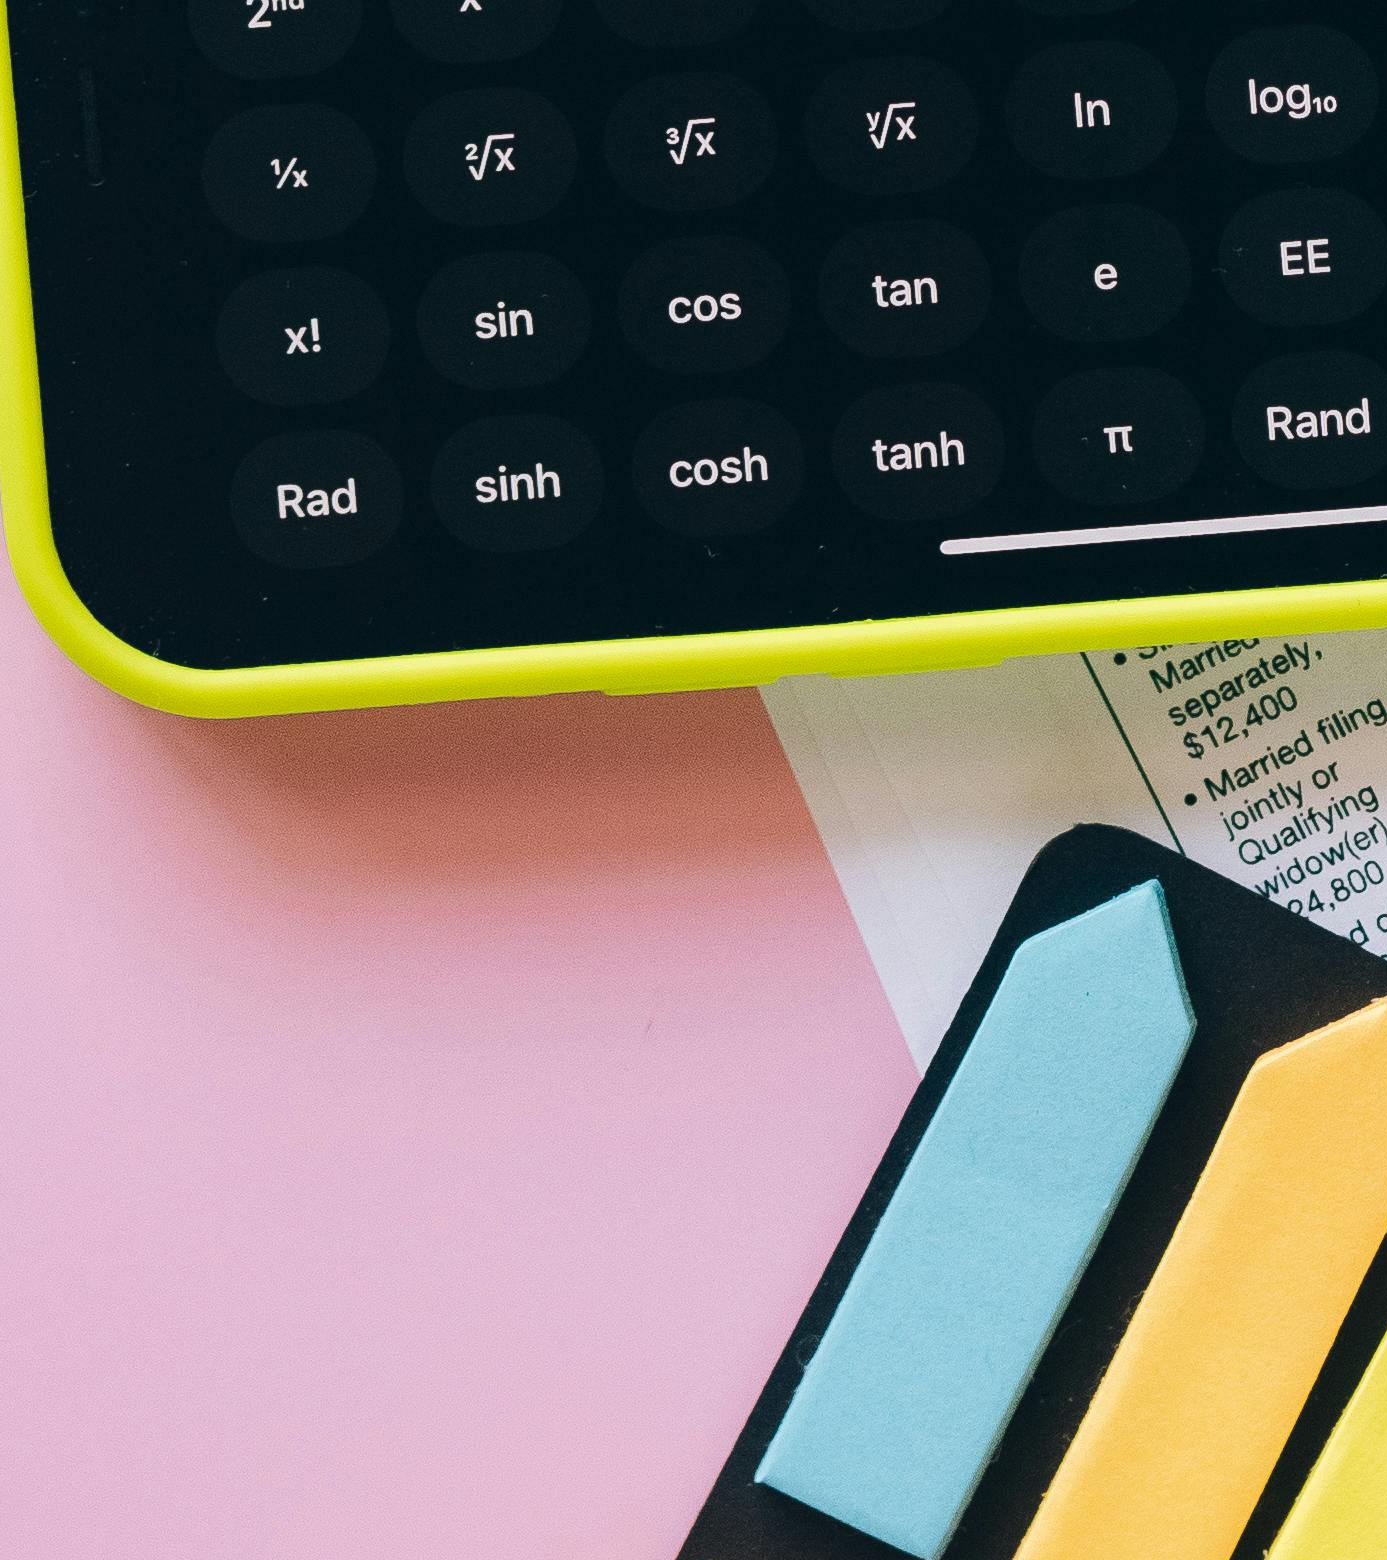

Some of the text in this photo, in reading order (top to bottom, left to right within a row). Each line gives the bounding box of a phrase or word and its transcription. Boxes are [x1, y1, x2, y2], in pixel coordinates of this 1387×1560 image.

[1277, 237, 1333, 278] EE
[666, 291, 743, 326] cos
[870, 274, 940, 309] tan
[473, 300, 536, 341] sin
[1264, 396, 1372, 443] Rand
[275, 476, 359, 521] Rad
[474, 461, 563, 505] sinh
[1166, 639, 1324, 728] separately,
[1181, 684, 1299, 761] $12,400
[1202, 728, 1316, 804] Married
